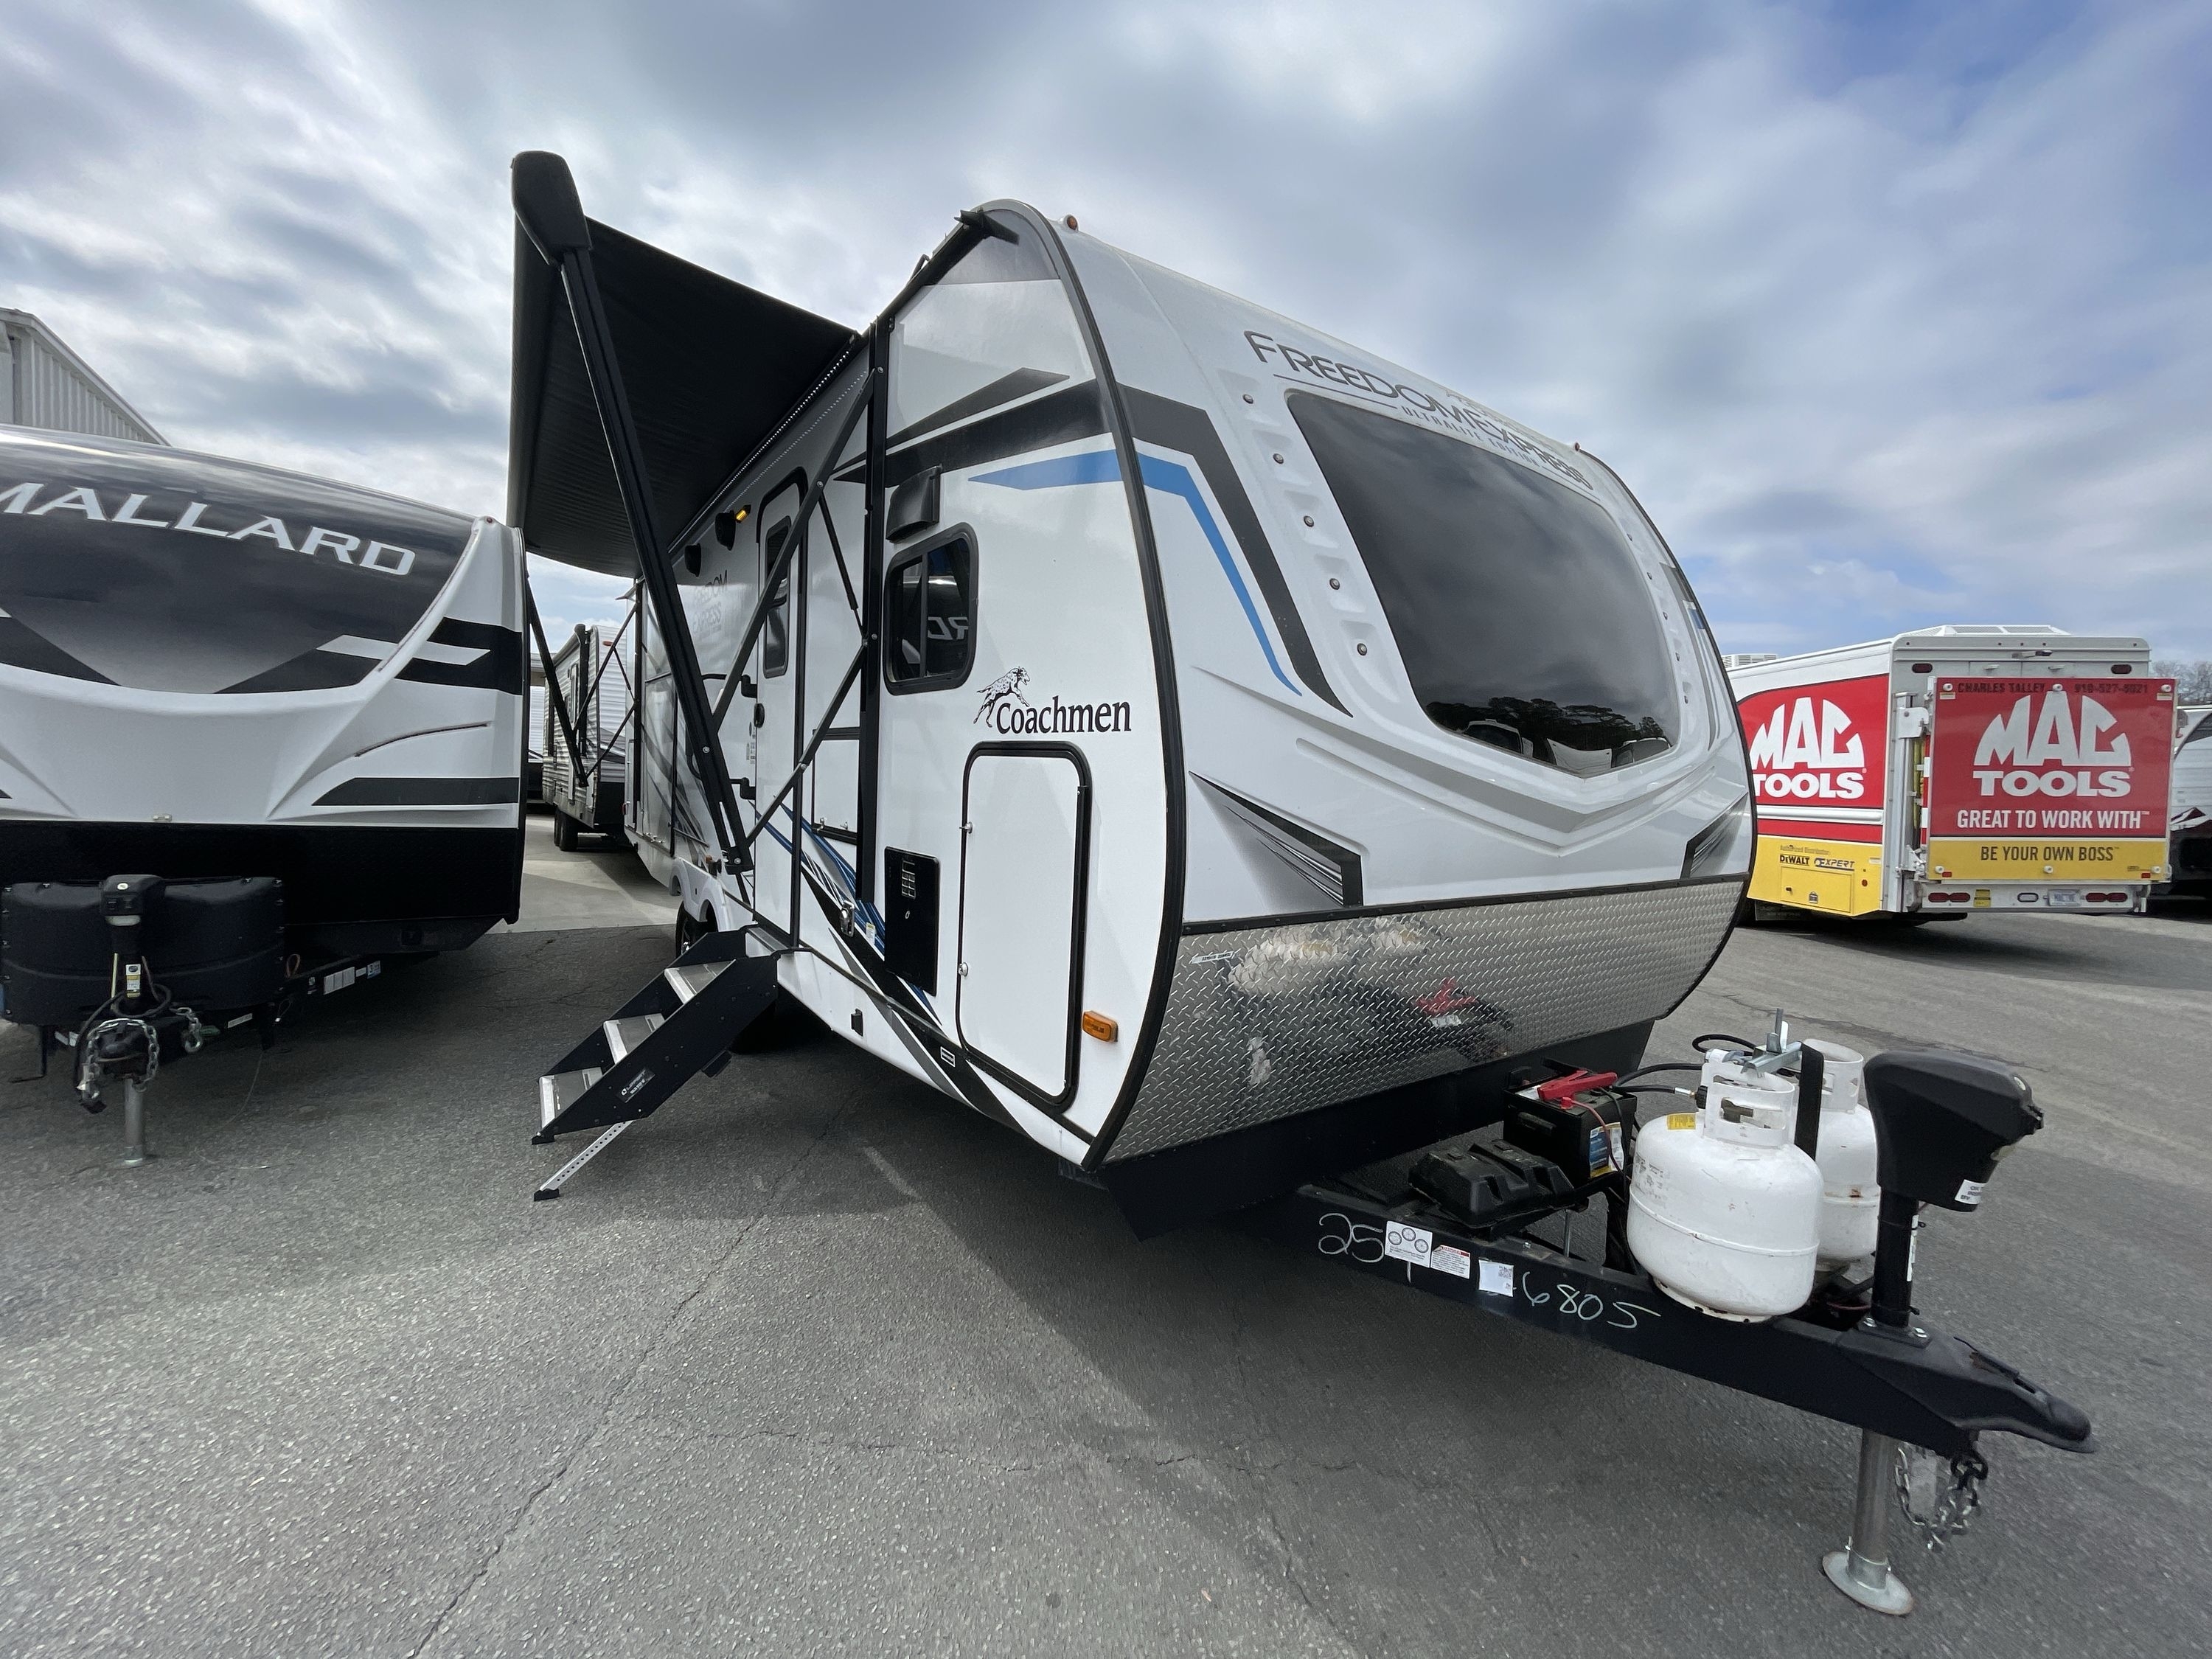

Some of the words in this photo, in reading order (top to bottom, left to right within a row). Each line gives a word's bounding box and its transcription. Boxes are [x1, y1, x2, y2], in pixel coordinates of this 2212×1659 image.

[996, 695, 1132, 734] Coachmen
[1974, 691, 2132, 767] MAC
[1750, 697, 1865, 770] MAC
[1753, 772, 1865, 799] TOOLS
[1973, 771, 2131, 797] TOOLS
[1957, 810, 2011, 829] GREAT
[2015, 810, 2037, 829] TO
[2042, 810, 2093, 830] WORK
[2097, 810, 2141, 830] WITH
[1980, 846, 1998, 861] BE
[2002, 846, 2039, 861] YOUR
[2042, 846, 2074, 861] OWN
[2078, 847, 2114, 861] BOSS
[1522, 1271, 1662, 1329] 6805
